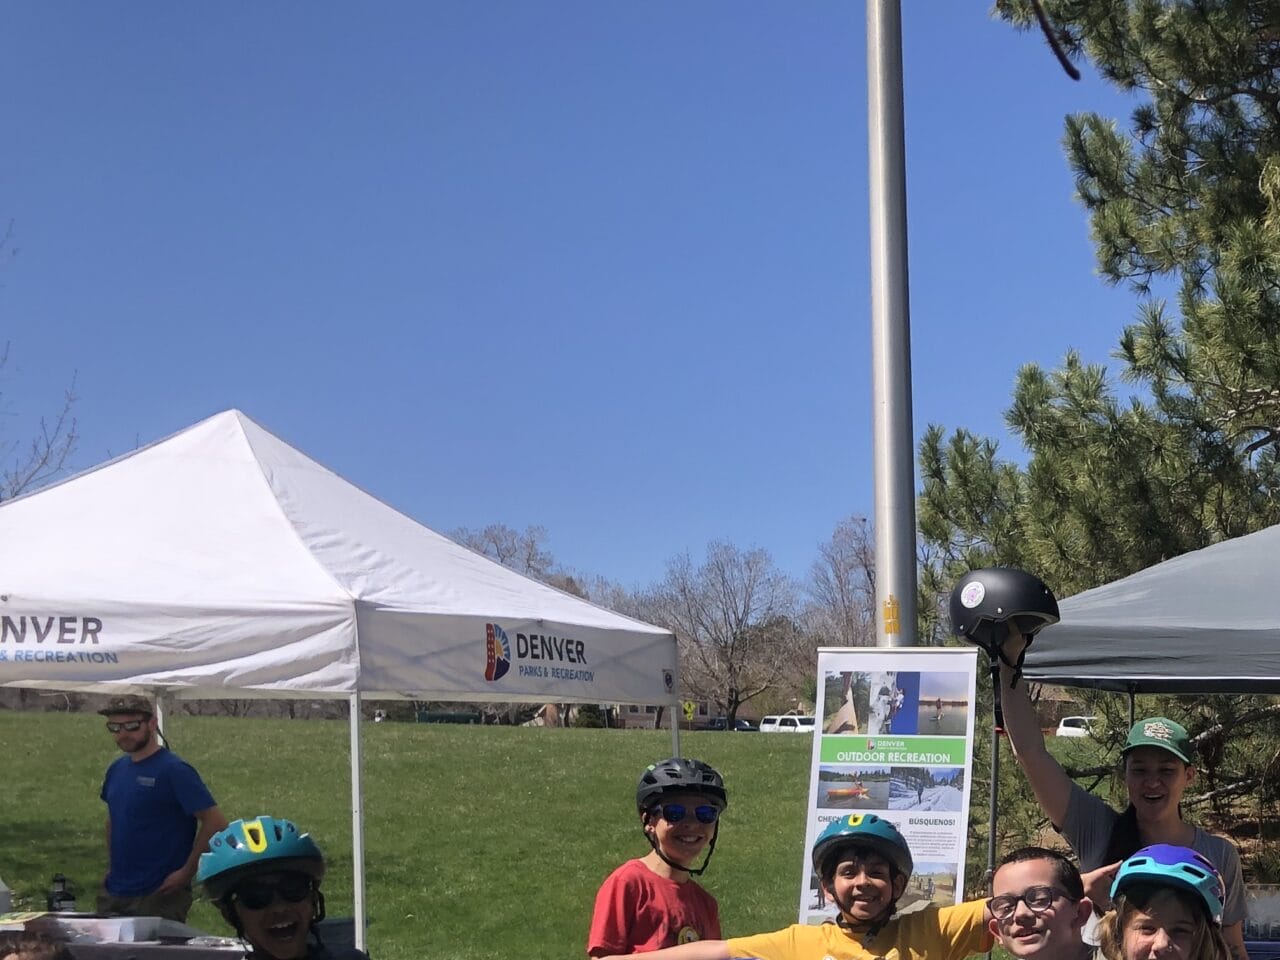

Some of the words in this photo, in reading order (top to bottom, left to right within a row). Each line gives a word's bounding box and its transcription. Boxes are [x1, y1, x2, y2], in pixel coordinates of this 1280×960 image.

[1, 616, 103, 644] NVER
[516, 633, 588, 665] DENVER
[14, 650, 119, 664] RECREATION
[519, 665, 542, 679] PARKS
[543, 667, 549, 678] &
[551, 667, 594, 682] RECREATION
[877, 740, 905, 748] DENVER
[837, 751, 885, 762] OUTDOOR
[887, 752, 951, 764] RECREATION
